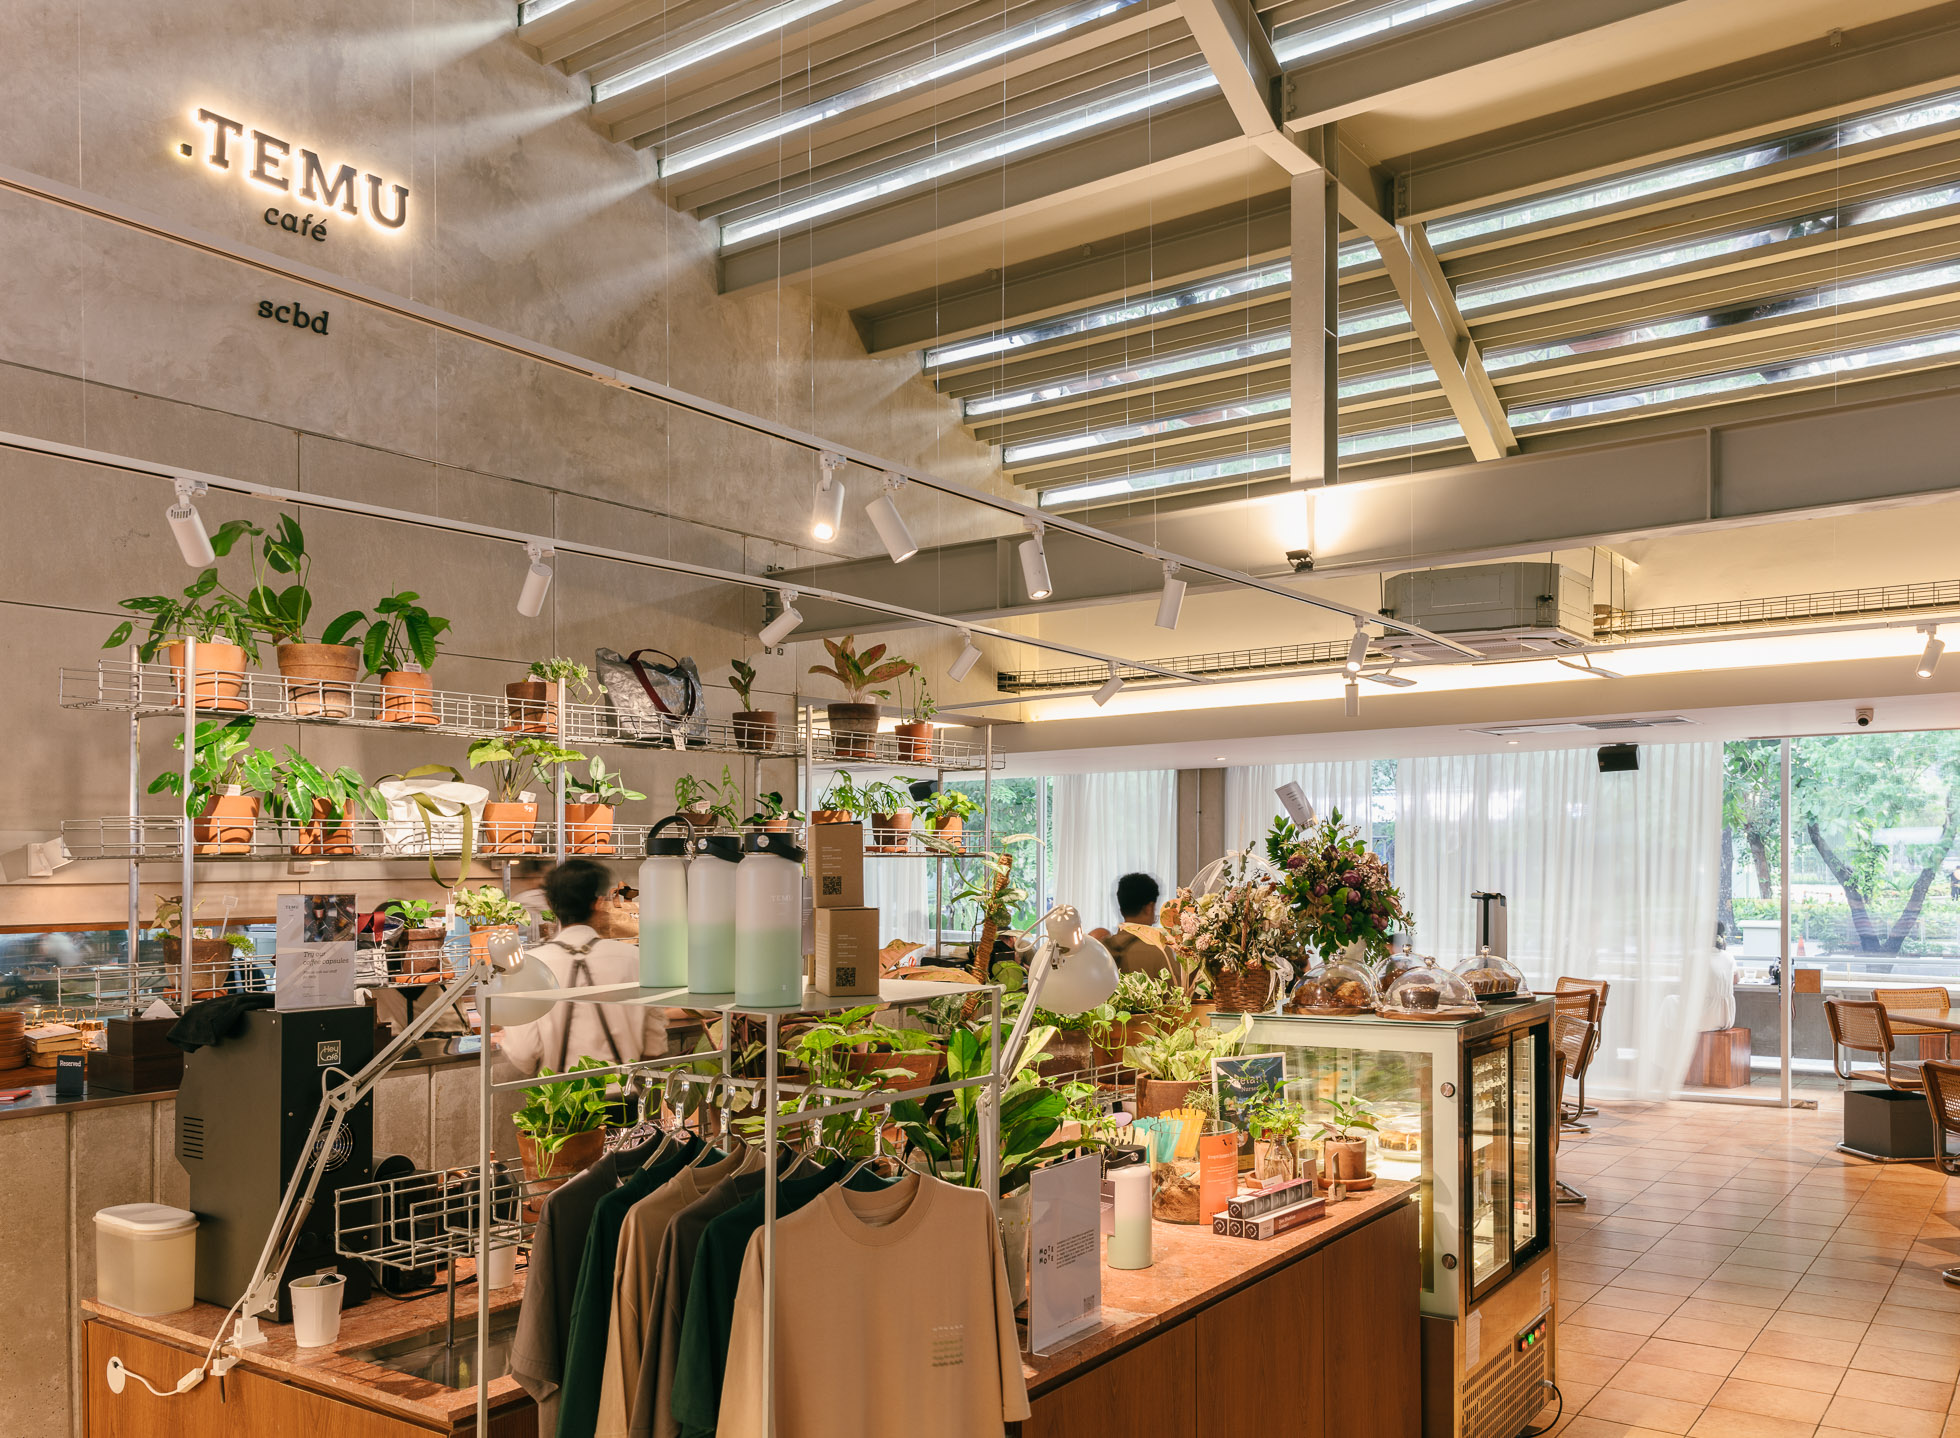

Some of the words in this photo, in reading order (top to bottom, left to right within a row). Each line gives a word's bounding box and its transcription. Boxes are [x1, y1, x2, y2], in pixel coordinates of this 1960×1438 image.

[263, 206, 328, 242] café
[257, 299, 330, 336] scbd
[322, 957, 350, 966] capsules
